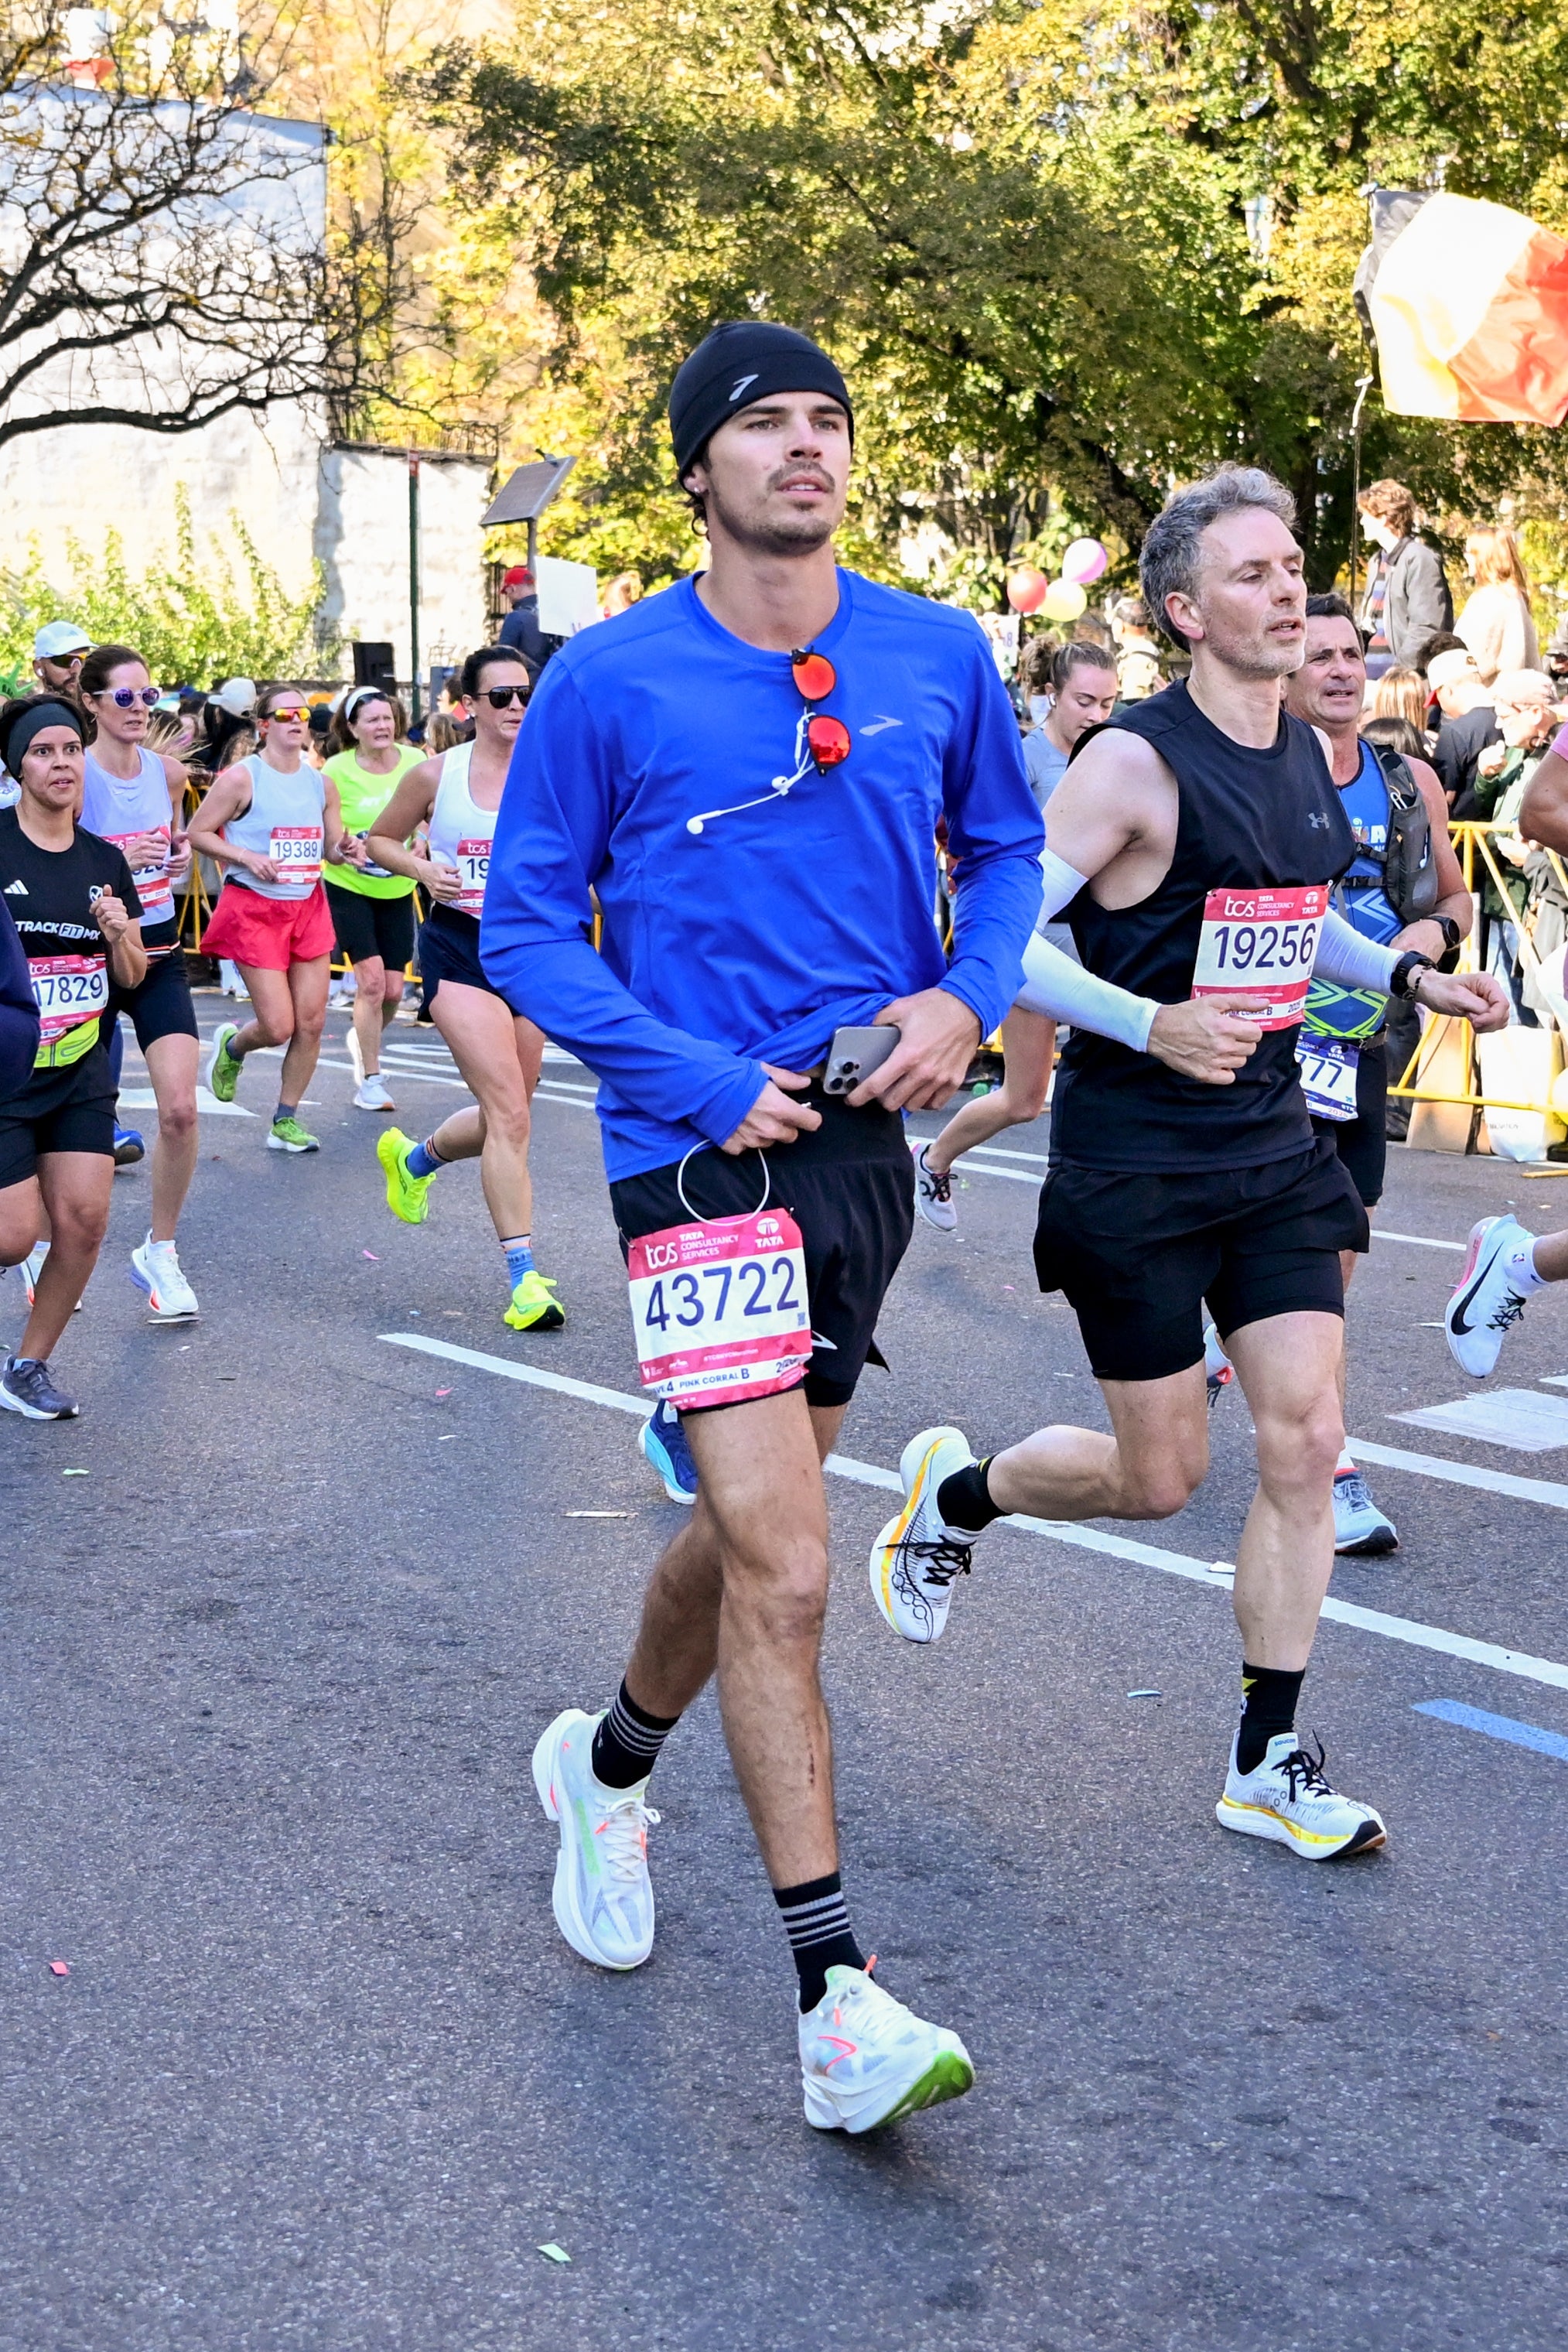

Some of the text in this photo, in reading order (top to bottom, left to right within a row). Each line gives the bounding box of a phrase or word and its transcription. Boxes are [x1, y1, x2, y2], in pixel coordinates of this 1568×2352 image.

[275, 841, 318, 858] 19389
[467, 842, 487, 854] tcs
[466, 857, 490, 880] 19
[1225, 895, 1255, 918] tcs
[1302, 906, 1318, 915] TATA
[1213, 922, 1317, 969] 19256
[29, 962, 51, 974] tcs
[31, 973, 104, 1007] 17829
[1266, 1007, 1273, 1016] B
[1327, 1051, 1345, 1062] TATA
[678, 1230, 705, 1242] TATA
[681, 1234, 739, 1252] CONSULTANCY
[755, 1235, 784, 1249] TATA
[644, 1241, 679, 1270] tcs
[682, 1246, 720, 1261] SERVICES
[645, 1256, 800, 1332] 43722
[666, 1380, 675, 1392] 4
[679, 1378, 700, 1389] PINK
[702, 1373, 740, 1385] CORRAL
[740, 1368, 750, 1379] B
